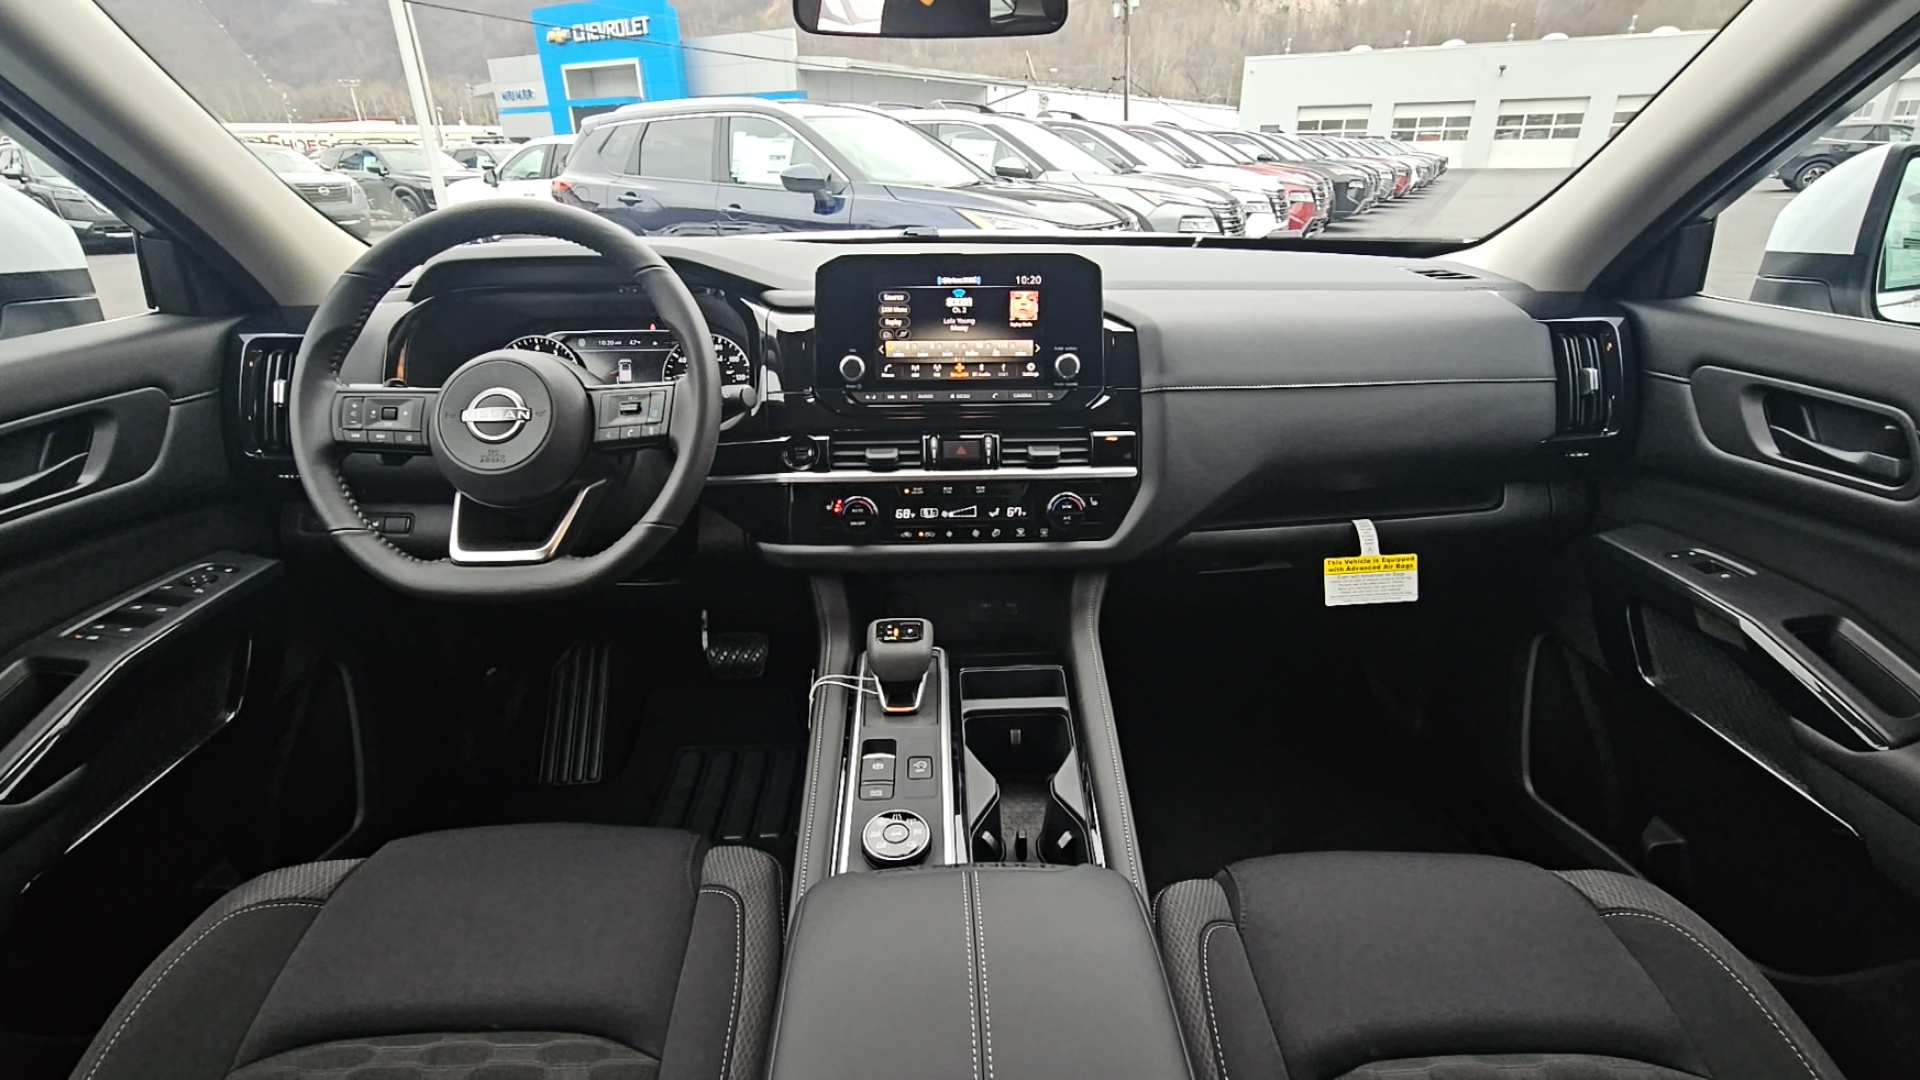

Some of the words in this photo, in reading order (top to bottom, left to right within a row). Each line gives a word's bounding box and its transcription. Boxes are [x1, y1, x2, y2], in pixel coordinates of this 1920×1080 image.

[571, 15, 651, 43] CHEVROLET
[1015, 275, 1042, 285] 10:20
[463, 408, 531, 421] NISSAN
[1346, 564, 1381, 572] Advanced
